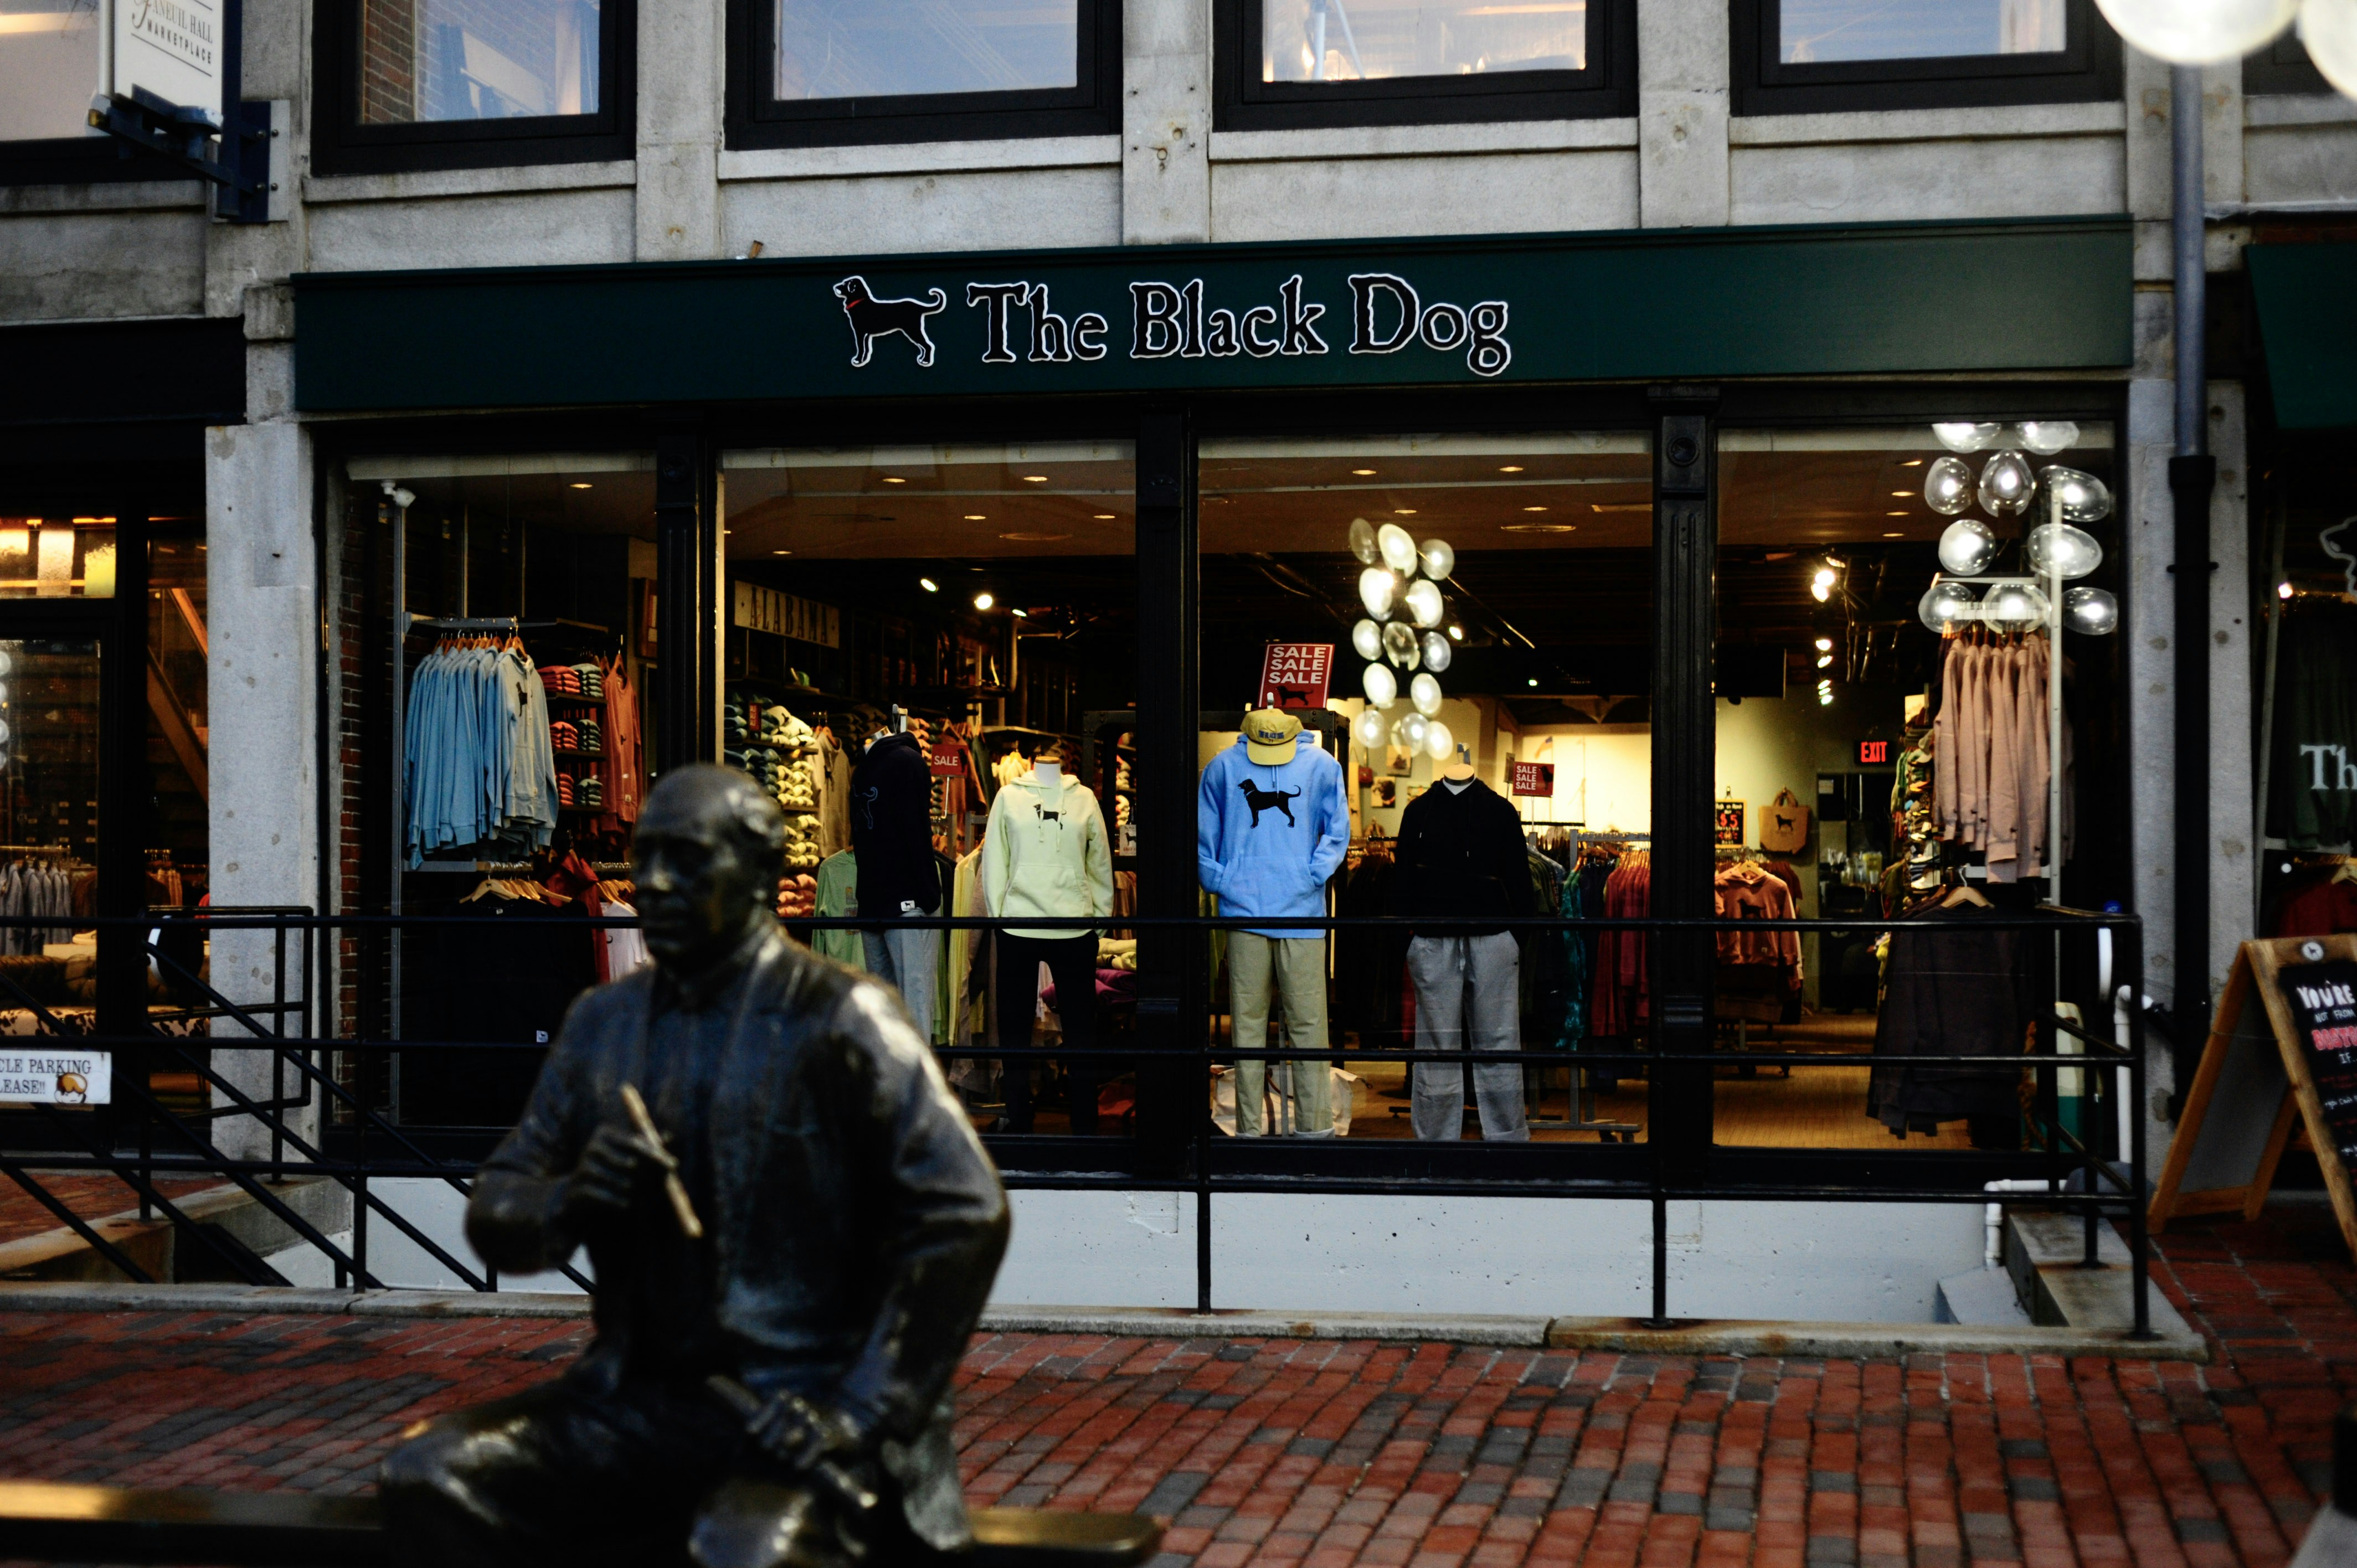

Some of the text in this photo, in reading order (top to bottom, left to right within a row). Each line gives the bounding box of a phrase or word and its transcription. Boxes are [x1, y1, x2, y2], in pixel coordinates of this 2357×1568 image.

[190, 14, 213, 44] HALL
[147, 18, 212, 64] MARKETPLACE
[966, 273, 1511, 377] The Black Dog
[749, 586, 828, 644] ALABAMA
[1272, 646, 1326, 658] SALE
[1270, 659, 1325, 670] SALE
[1268, 672, 1323, 684] SALE
[1861, 741, 1887, 762] EXIT
[934, 755, 959, 766] SALE
[1516, 765, 1537, 773] SALE
[1516, 773, 1537, 782] SALE
[1515, 781, 1536, 790] SALE
[2297, 981, 2355, 1009] YOU'RE
[2314, 1009, 2356, 1023] NOT FROM
[29, 1058, 91, 1074] PARKING
